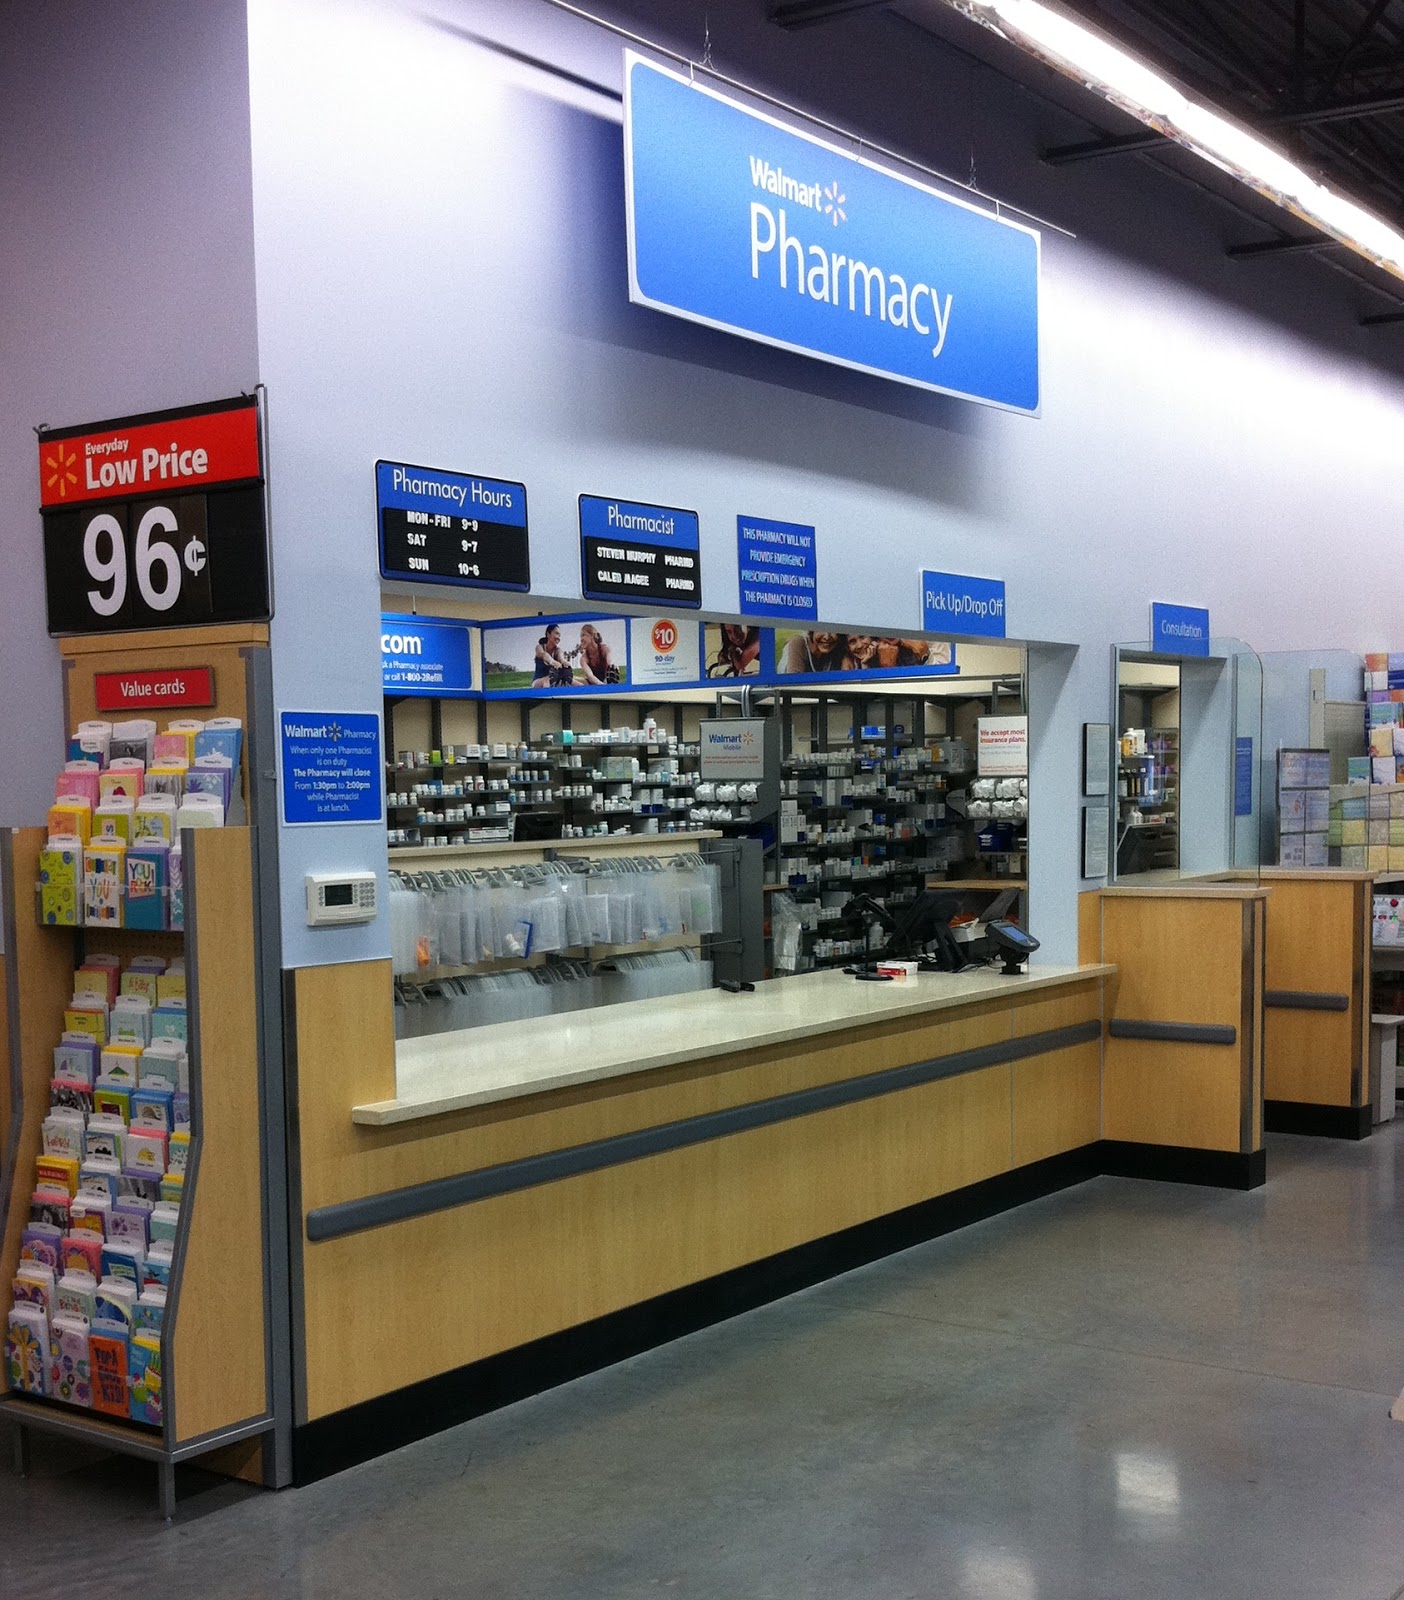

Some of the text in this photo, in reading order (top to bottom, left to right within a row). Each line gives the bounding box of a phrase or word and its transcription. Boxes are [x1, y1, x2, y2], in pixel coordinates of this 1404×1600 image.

[749, 155, 822, 212] Walmart
[750, 201, 953, 358] Pharmacy
[85, 438, 129, 456] Everyday
[85, 443, 208, 490] Low Price
[393, 467, 512, 508] Pharmacy Hours
[461, 518, 479, 532] 9-9
[608, 504, 674, 535] Pharmacist
[407, 533, 478, 553] SAT 9-7
[743, 527, 811, 548] THIS PHARMACY WILL NOT
[596, 546, 625, 560] STEVEN
[626, 549, 656, 564] MURPHY
[749, 549, 774, 563] PROVIDE
[408, 557, 480, 576] SUN 10-6
[597, 570, 622, 583] CALEB
[780, 573, 798, 586] DRUGS
[799, 575, 815, 588] WHEN
[744, 590, 756, 603] THE
[756, 591, 786, 606] PHARMACY
[793, 595, 813, 608] CLOSED
[926, 590, 946, 611] Pick
[988, 598, 1003, 617] Off
[655, 628, 674, 644] $10
[1161, 619, 1203, 638] Consultation
[120, 678, 186, 697] Value cards
[284, 724, 377, 740] Walmart Pharmacy
[709, 733, 742, 743] Walmart
[289, 745, 310, 754] When
[310, 746, 325, 756] only
[338, 745, 372, 755] Pharmacist
[293, 768, 371, 778] The Pharmacy will close
